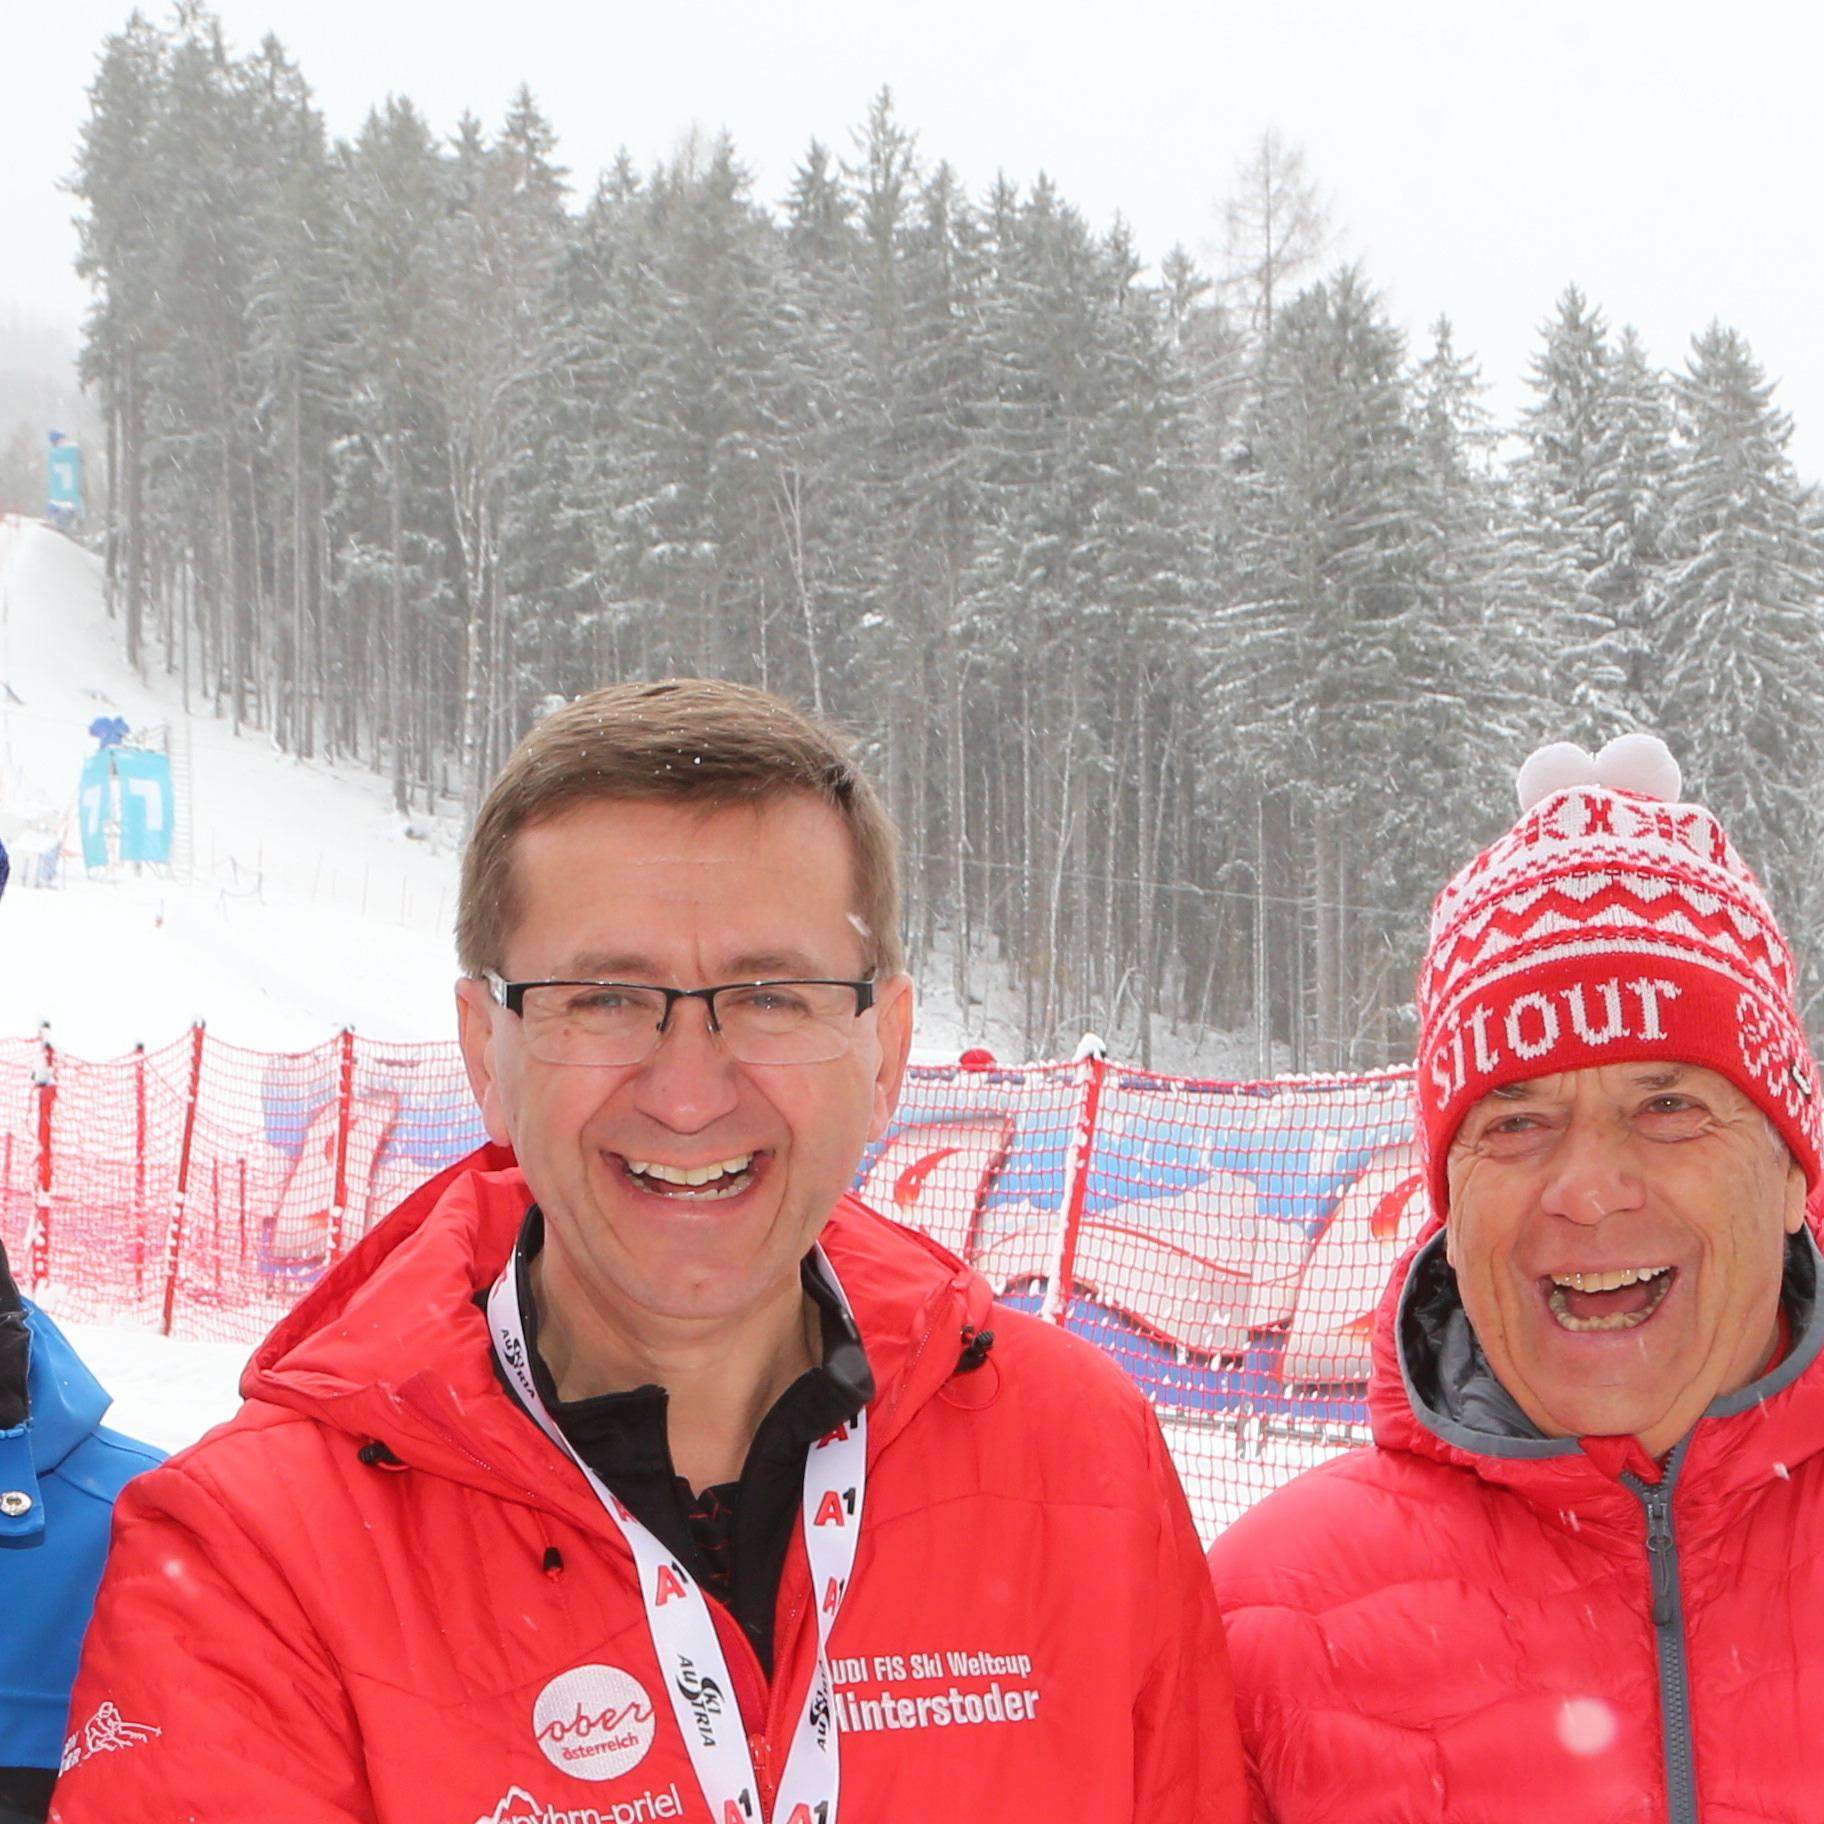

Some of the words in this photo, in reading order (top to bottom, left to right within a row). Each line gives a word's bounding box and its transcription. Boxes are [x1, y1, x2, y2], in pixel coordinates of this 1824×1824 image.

[814, 1487, 856, 1526] A1
[656, 1561, 687, 1606] A1
[832, 1657, 869, 1685] UDI
[874, 1656, 907, 1682] FIS
[910, 1653, 943, 1680] Ski
[946, 1651, 1032, 1680] Weltcup
[537, 1701, 654, 1742] ober
[562, 1732, 639, 1761] österreich
